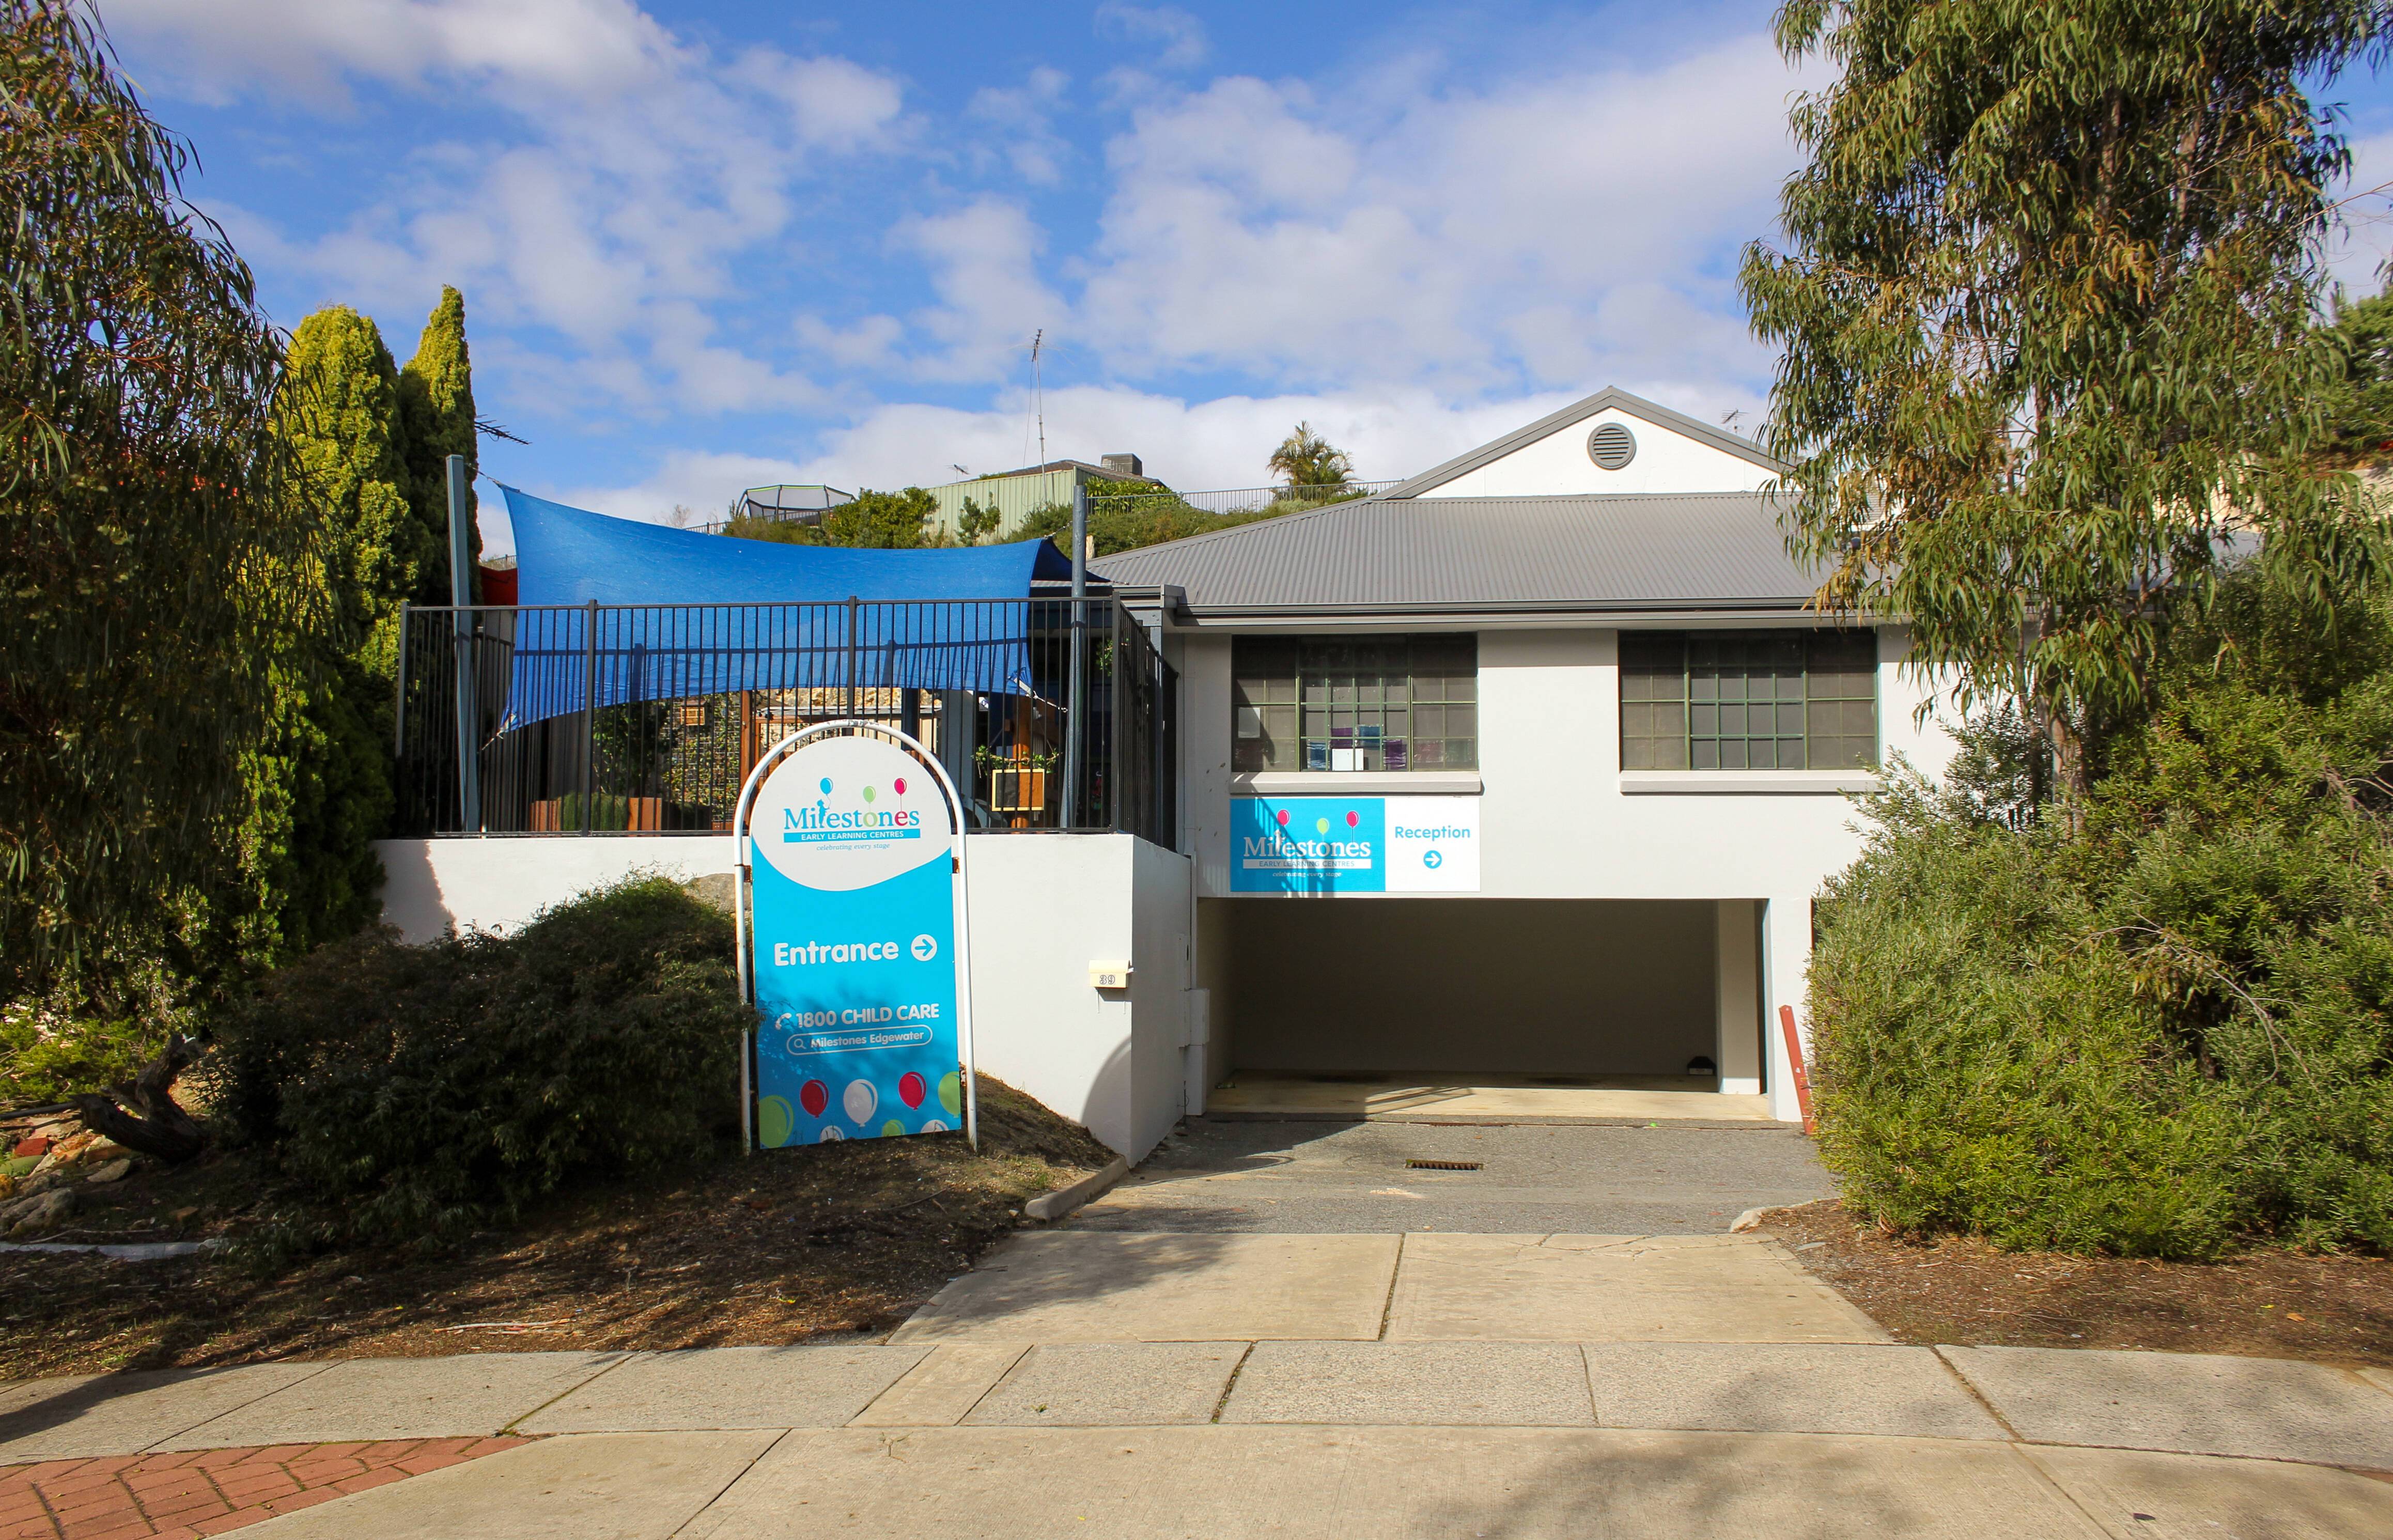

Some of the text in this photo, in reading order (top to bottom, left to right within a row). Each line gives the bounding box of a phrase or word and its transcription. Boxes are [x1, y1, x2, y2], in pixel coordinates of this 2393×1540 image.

[784, 800, 920, 830] Milestones
[828, 832, 867, 840] LEARNING
[869, 830, 904, 838] CENTRES
[1243, 830, 1371, 858] Milestones
[1395, 825, 1471, 842] Reception
[774, 940, 899, 966] Entrance
[1099, 974, 1116, 985] 39
[795, 1003, 940, 1028] 1800 CHILD CARE
[811, 1031, 925, 1049] Milestones Edgewater
